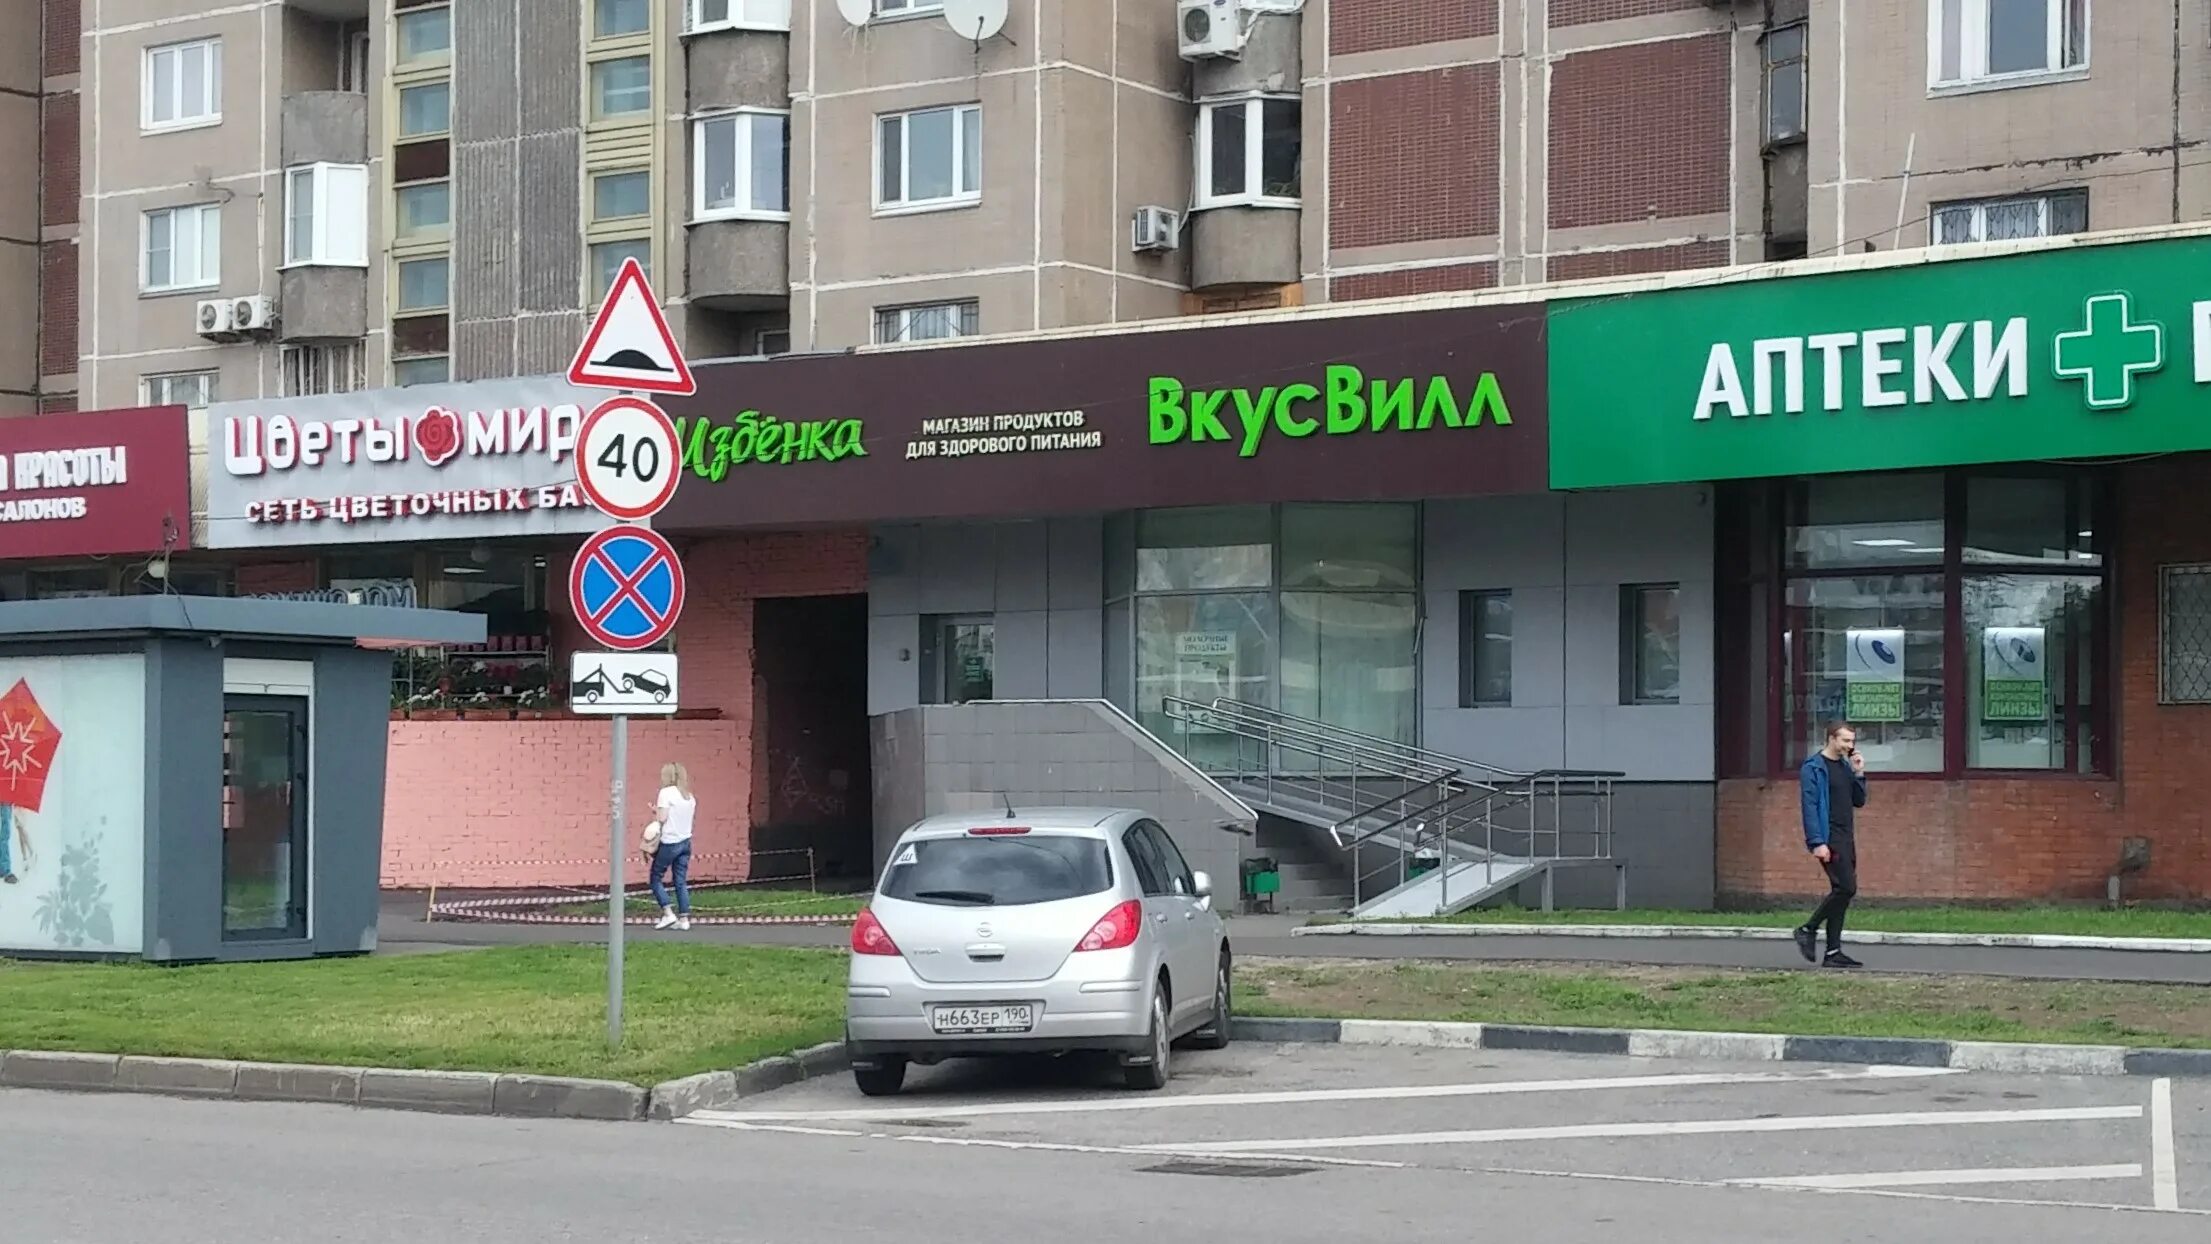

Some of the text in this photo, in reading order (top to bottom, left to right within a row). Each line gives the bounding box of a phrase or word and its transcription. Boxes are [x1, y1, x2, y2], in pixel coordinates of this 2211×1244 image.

[1693, 316, 2028, 420] АПТЕКИ
[923, 410, 1084, 435] МАГАЗИН ПРОДУКТОВ
[1149, 363, 1514, 458] ВкусВилл
[597, 433, 659, 482] 40
[676, 410, 869, 482] Избёнка
[905, 431, 1102, 459] ДЛЯ ЗДОРОВОГО ПИТАНИЯ
[14, 446, 127, 490] КРАСОТЫ
[244, 484, 594, 523] СЕТЬ ЦВЕТОЧНЫХ БА
[1851, 703, 1900, 717] ЛИНЗЫ
[1989, 701, 2041, 716] ЛИНЗЫ
[1005, 1007, 1026, 1020] 190
